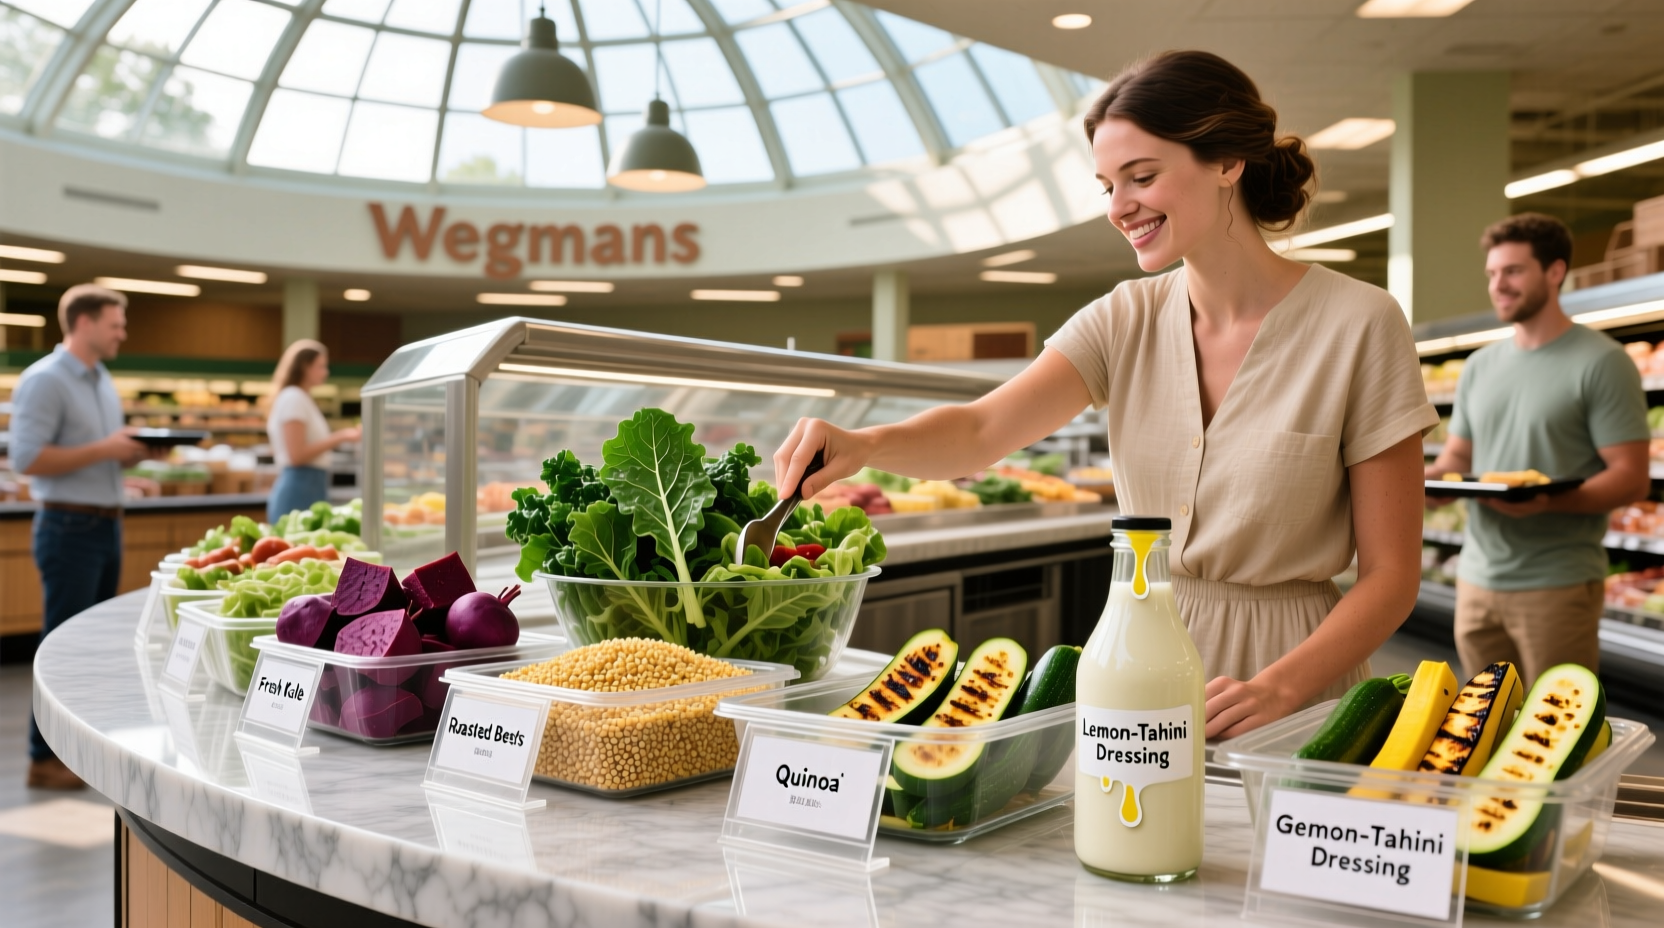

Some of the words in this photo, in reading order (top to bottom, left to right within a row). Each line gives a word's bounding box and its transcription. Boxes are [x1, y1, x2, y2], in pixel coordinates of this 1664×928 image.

[366, 203, 701, 279] Wegmans
[1082, 717, 1187, 742] Lemon-Tahini
[1096, 743, 1170, 769] Dressing
[1276, 814, 1444, 854] Gemon-Tahini
[1310, 846, 1411, 885] Dressing
